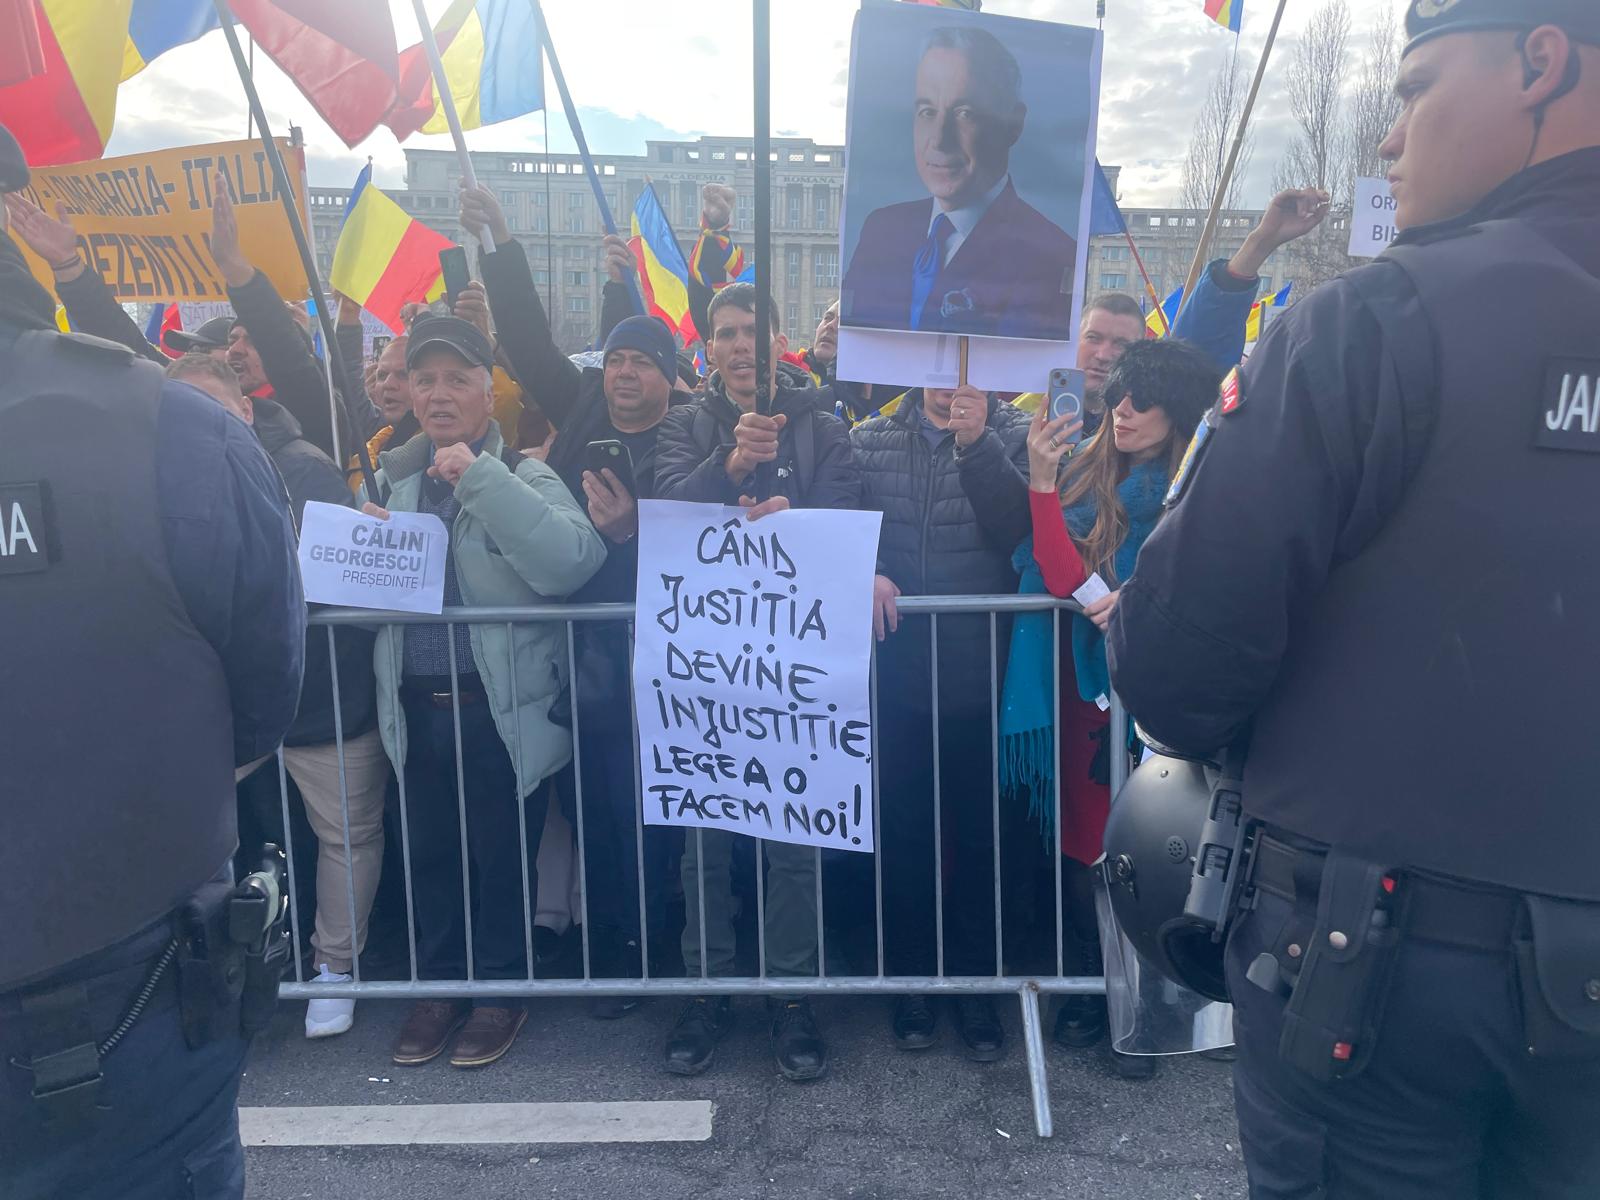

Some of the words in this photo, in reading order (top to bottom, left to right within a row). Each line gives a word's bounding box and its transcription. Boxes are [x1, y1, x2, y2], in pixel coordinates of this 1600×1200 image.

[351, 522, 424, 552] CĂLIN
[697, 518, 796, 579] CÂND
[310, 545, 421, 572] GEORGESCU
[666, 642, 828, 703] DEVINE
[784, 767, 807, 794] O
[648, 784, 772, 831] FACEM
